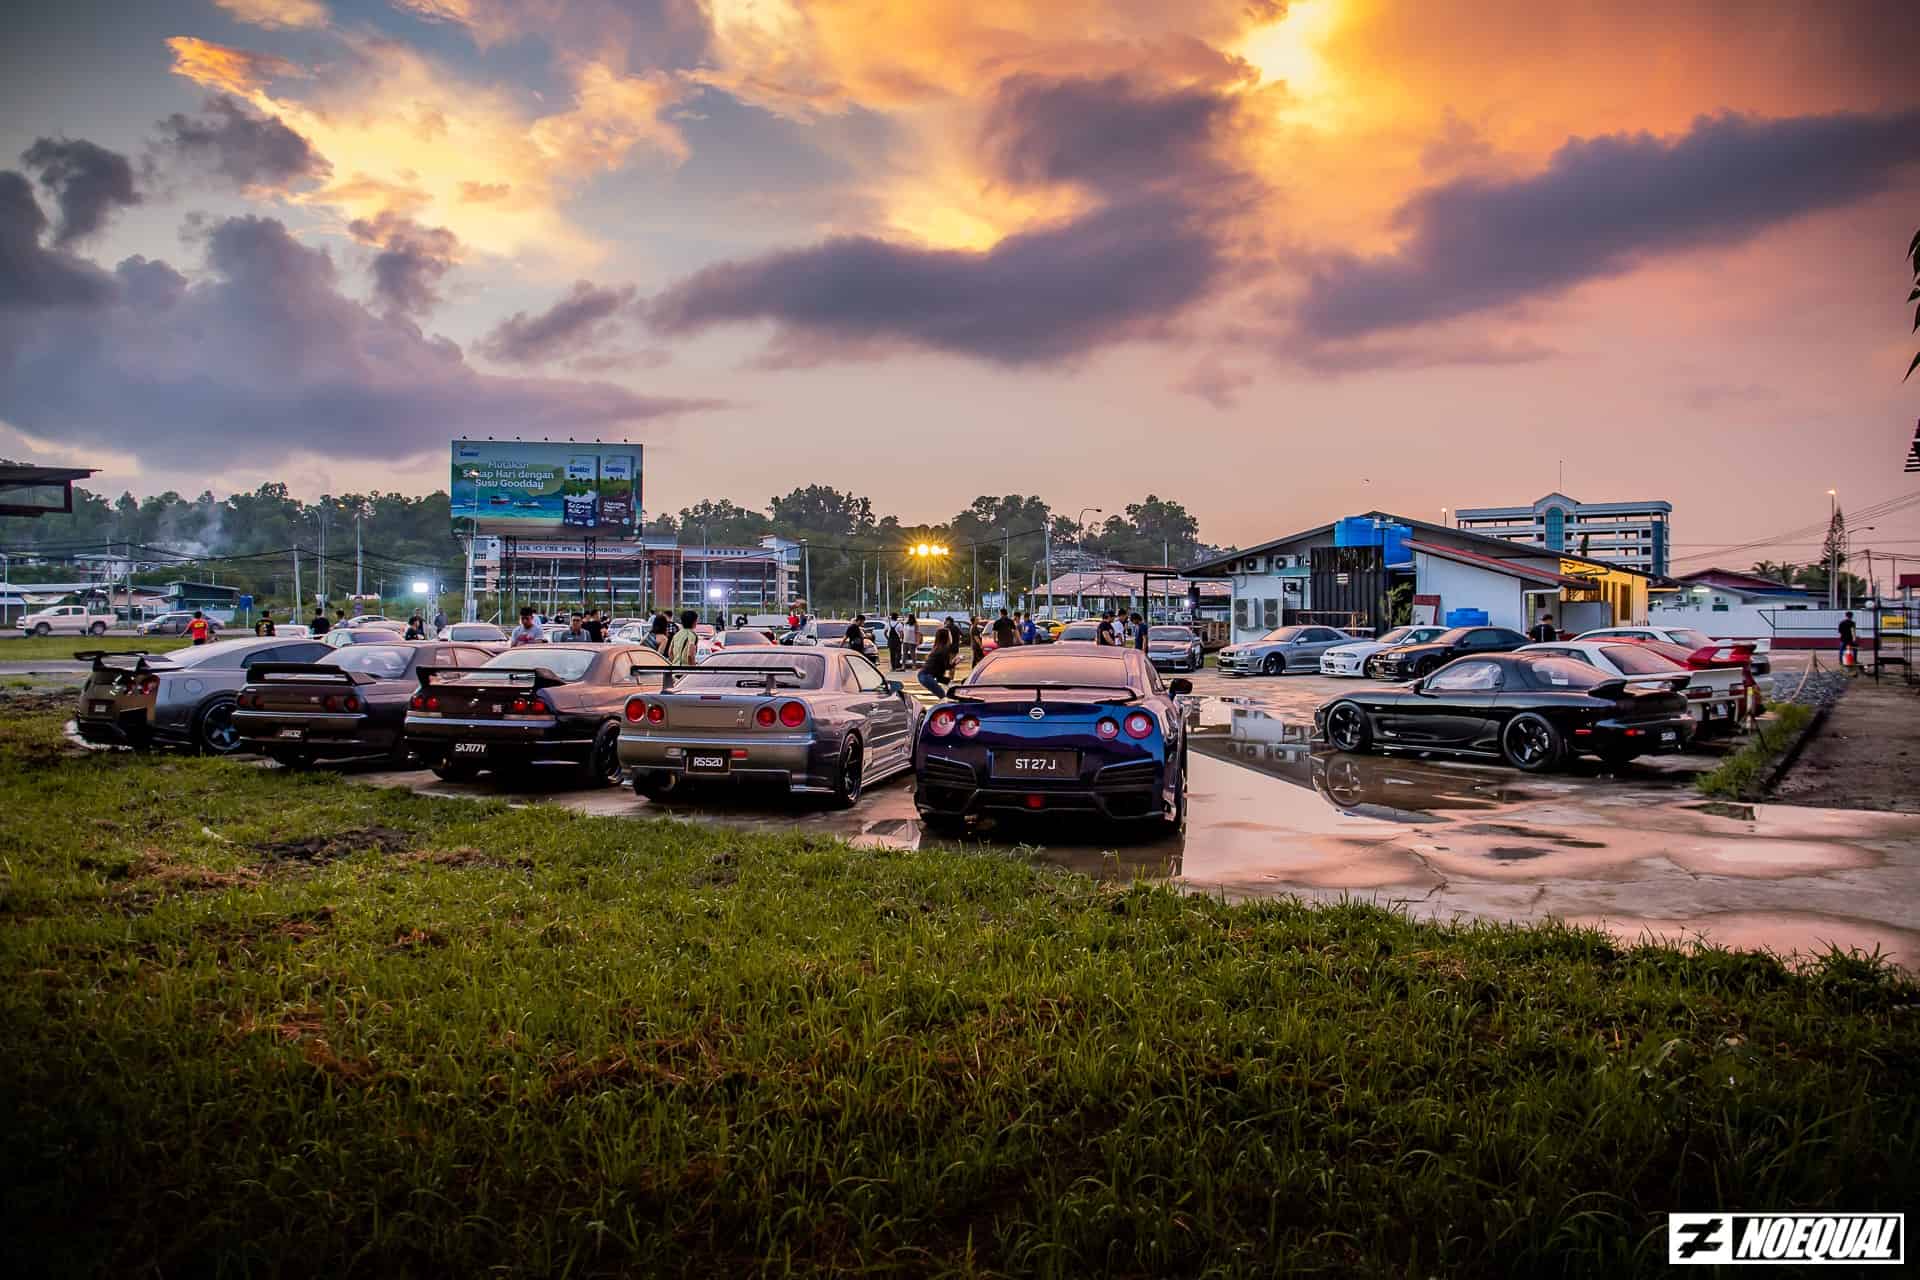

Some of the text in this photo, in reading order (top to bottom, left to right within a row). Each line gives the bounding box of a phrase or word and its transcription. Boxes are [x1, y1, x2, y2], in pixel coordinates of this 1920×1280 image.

[518, 470, 554, 480] dengan
[475, 479, 544, 489] Susu Goodday
